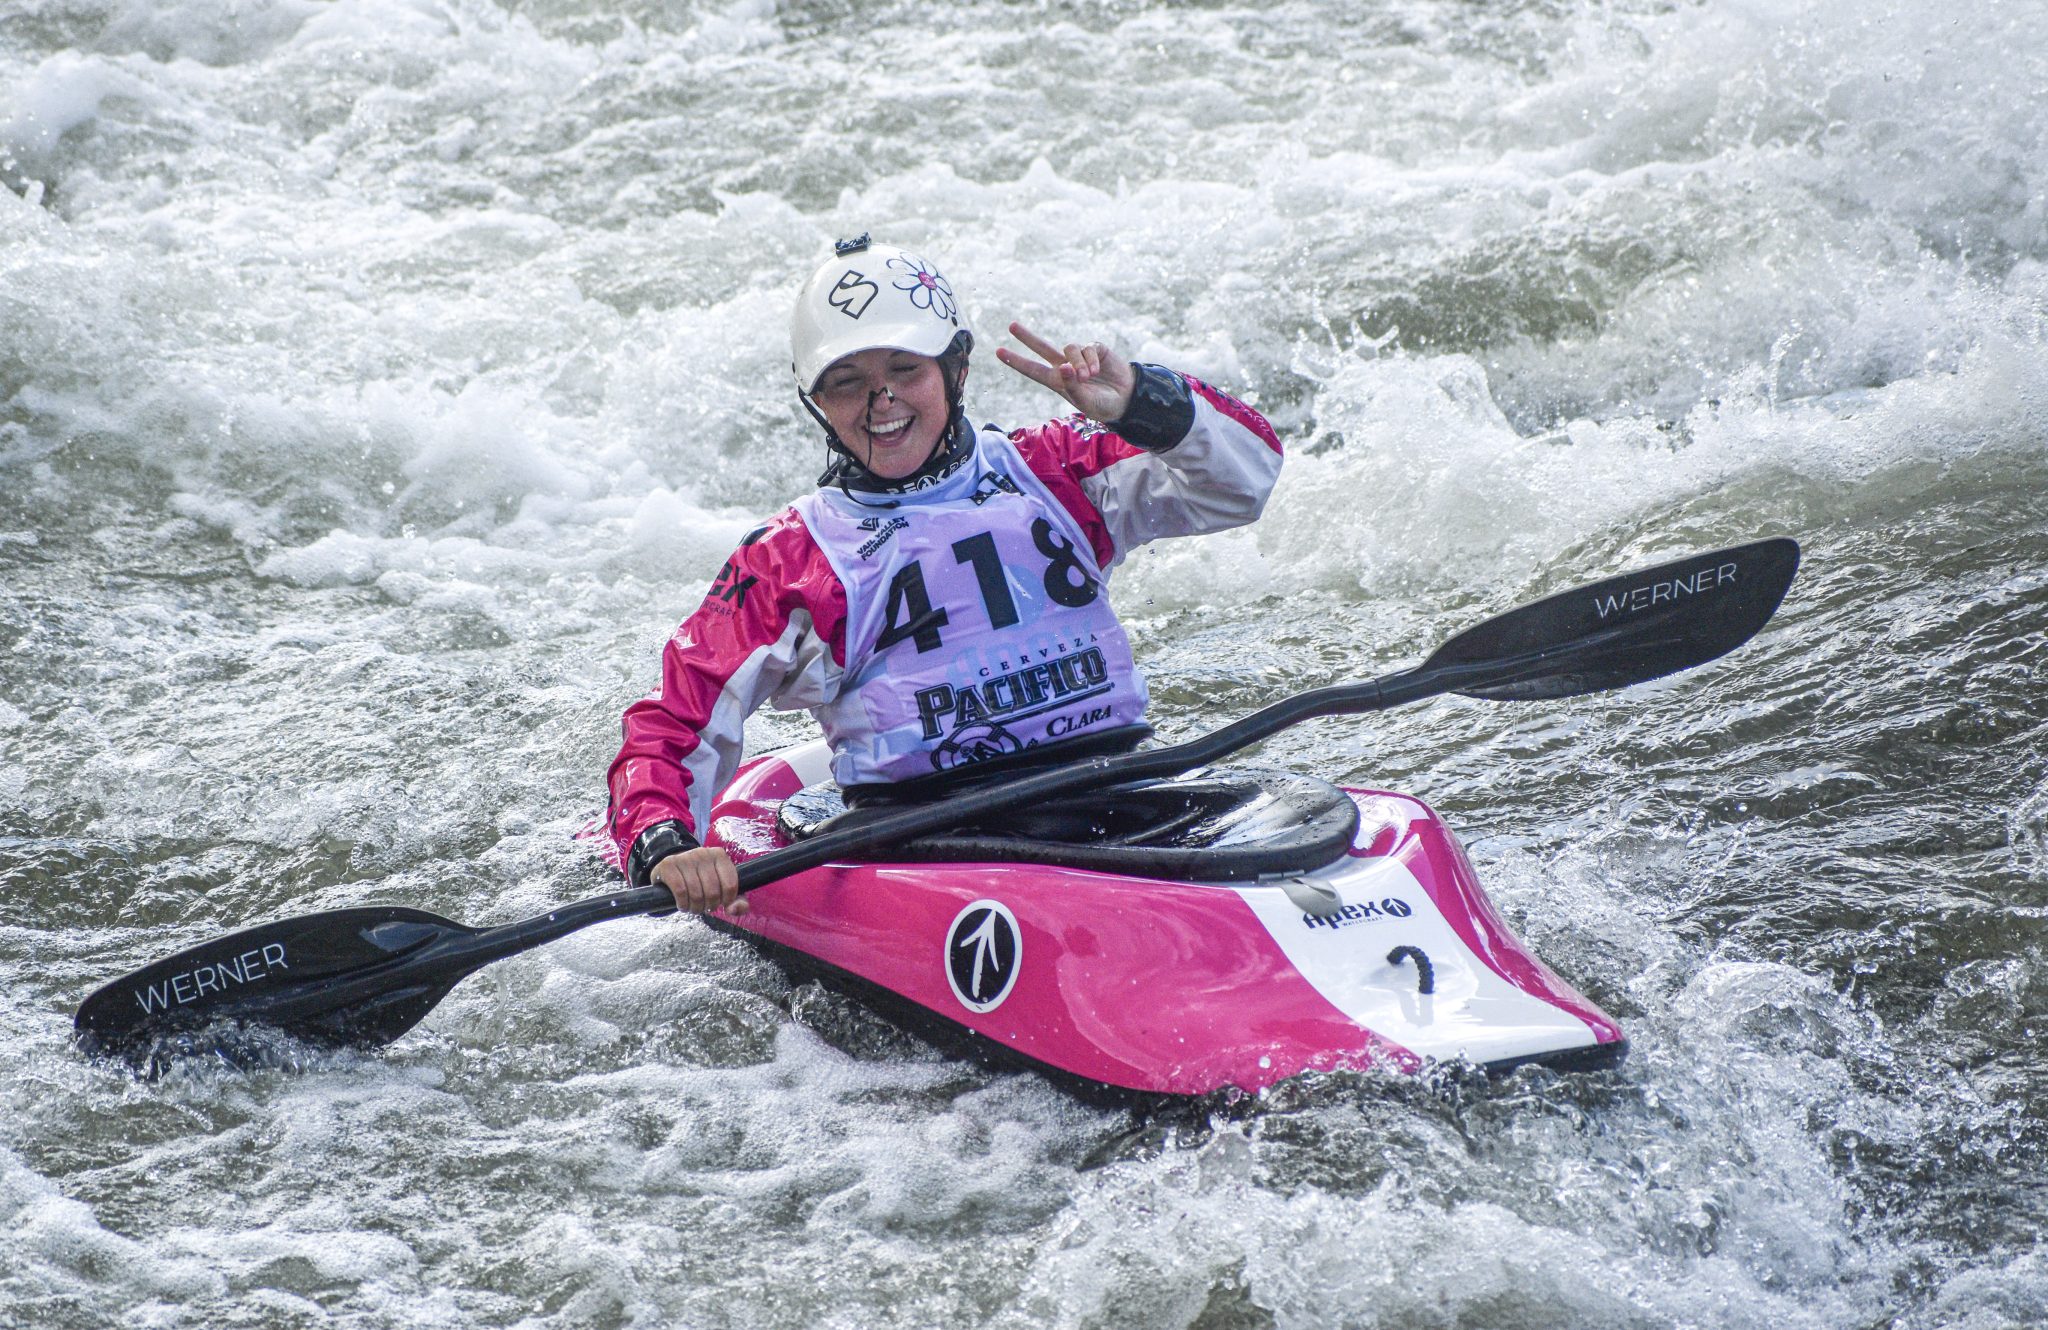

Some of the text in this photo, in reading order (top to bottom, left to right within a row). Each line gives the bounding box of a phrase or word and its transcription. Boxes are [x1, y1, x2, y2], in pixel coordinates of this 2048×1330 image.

[857, 516, 905, 555] VAIL VALLEY
[861, 521, 909, 561] FOUNDATION
[873, 517, 1099, 654] 418
[1595, 562, 1737, 619] WERNER
[978, 633, 1098, 677] CERVEZA
[914, 646, 1107, 741] PACIFICO
[135, 943, 289, 1014] WERNER
